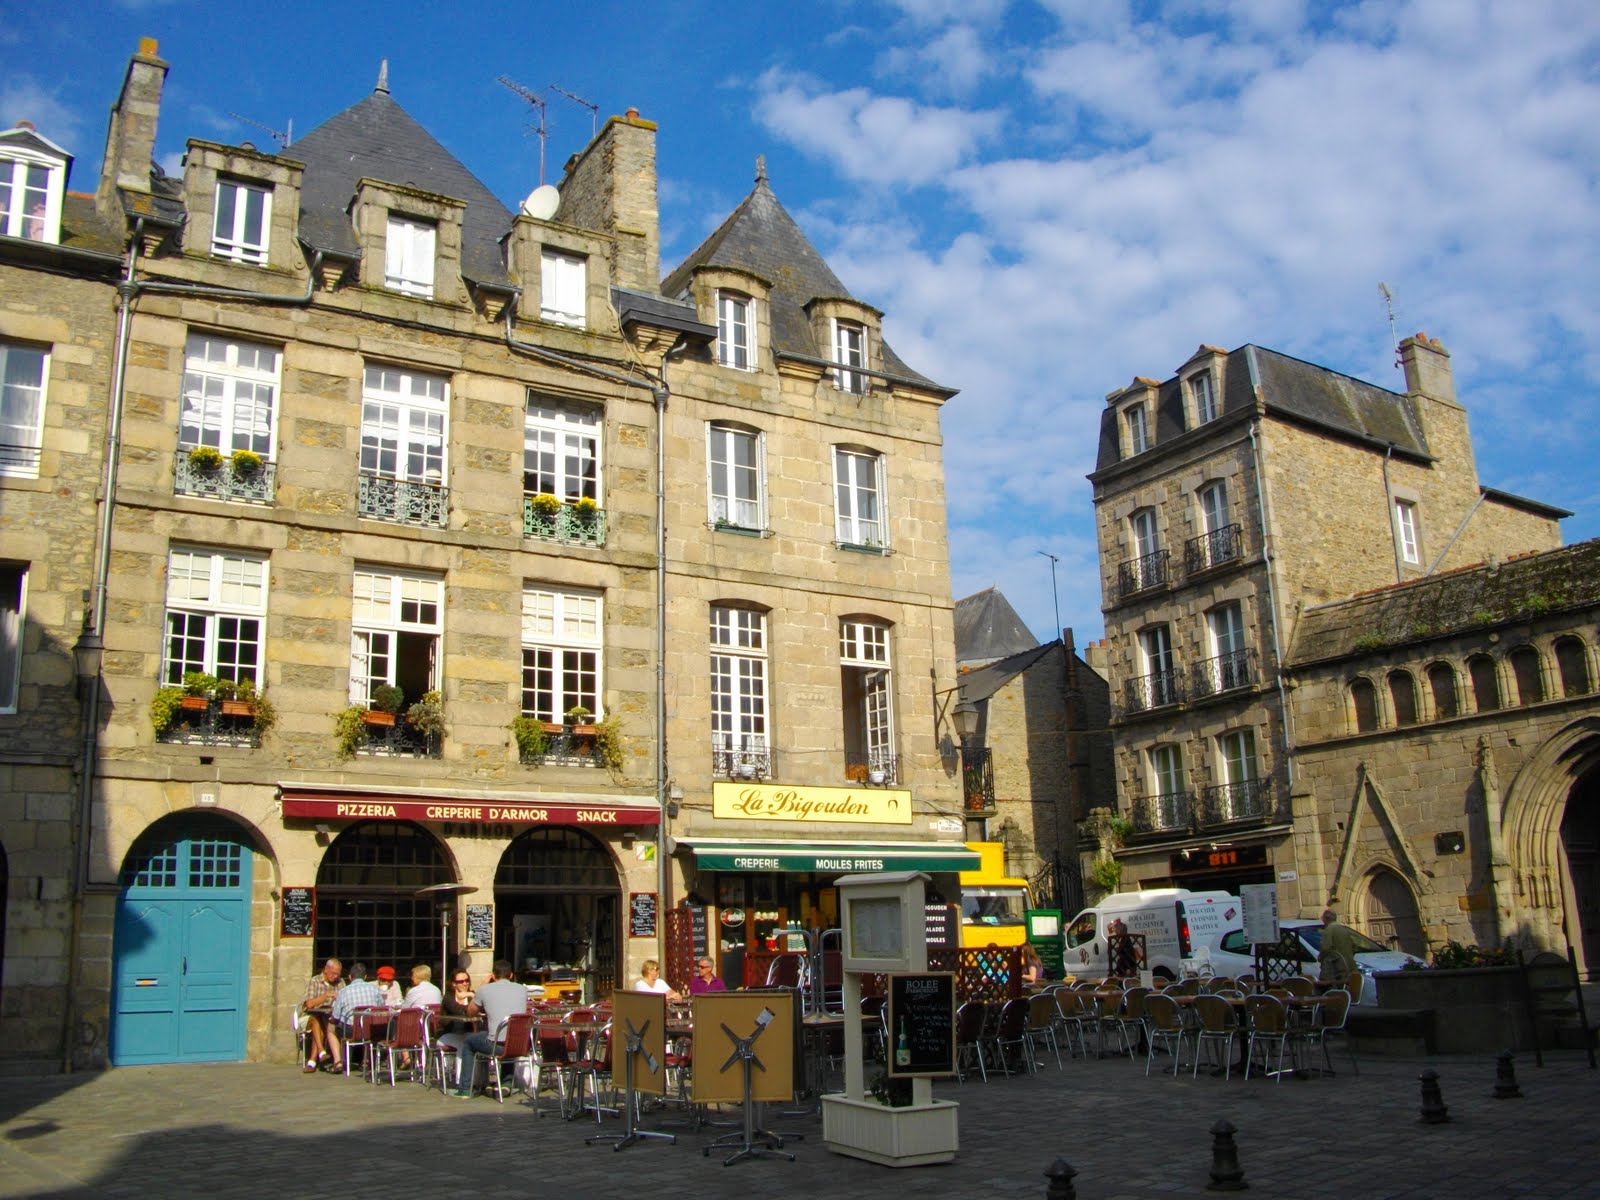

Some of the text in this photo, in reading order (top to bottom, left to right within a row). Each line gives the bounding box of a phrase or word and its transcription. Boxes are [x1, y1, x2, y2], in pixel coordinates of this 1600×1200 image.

[731, 788, 869, 820] La Bigouden
[336, 804, 396, 817] PIZZERIA
[426, 806, 548, 821] CREPERIE D'ARMOR
[576, 810, 617, 822] SNACK
[734, 857, 779, 869] CREPERIE
[815, 859, 884, 870] MOULES FRITES
